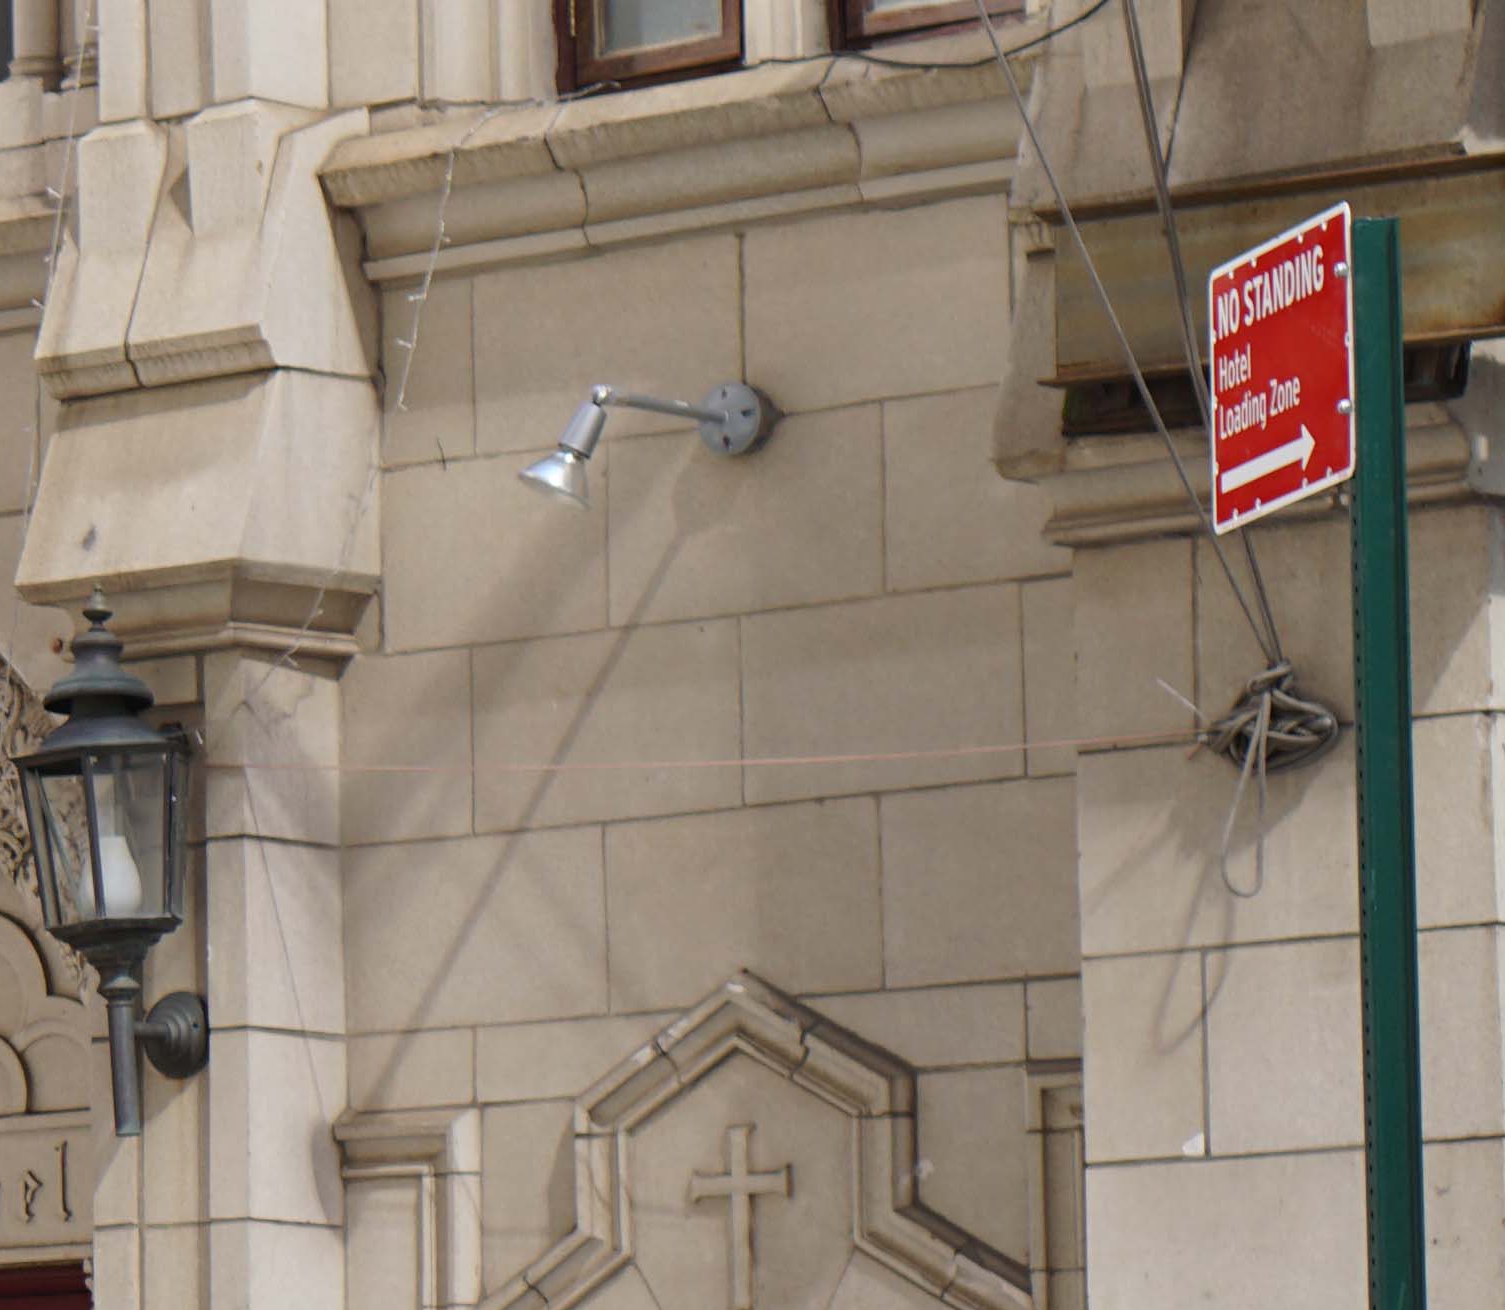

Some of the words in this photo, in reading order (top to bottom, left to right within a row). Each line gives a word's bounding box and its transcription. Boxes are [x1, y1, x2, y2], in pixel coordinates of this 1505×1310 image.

[1217, 288, 1241, 340] NO
[1243, 245, 1325, 327] STANDING
[1219, 343, 1251, 392] Hotel
[1220, 390, 1267, 440] Loading
[1269, 376, 1301, 415] Zone
